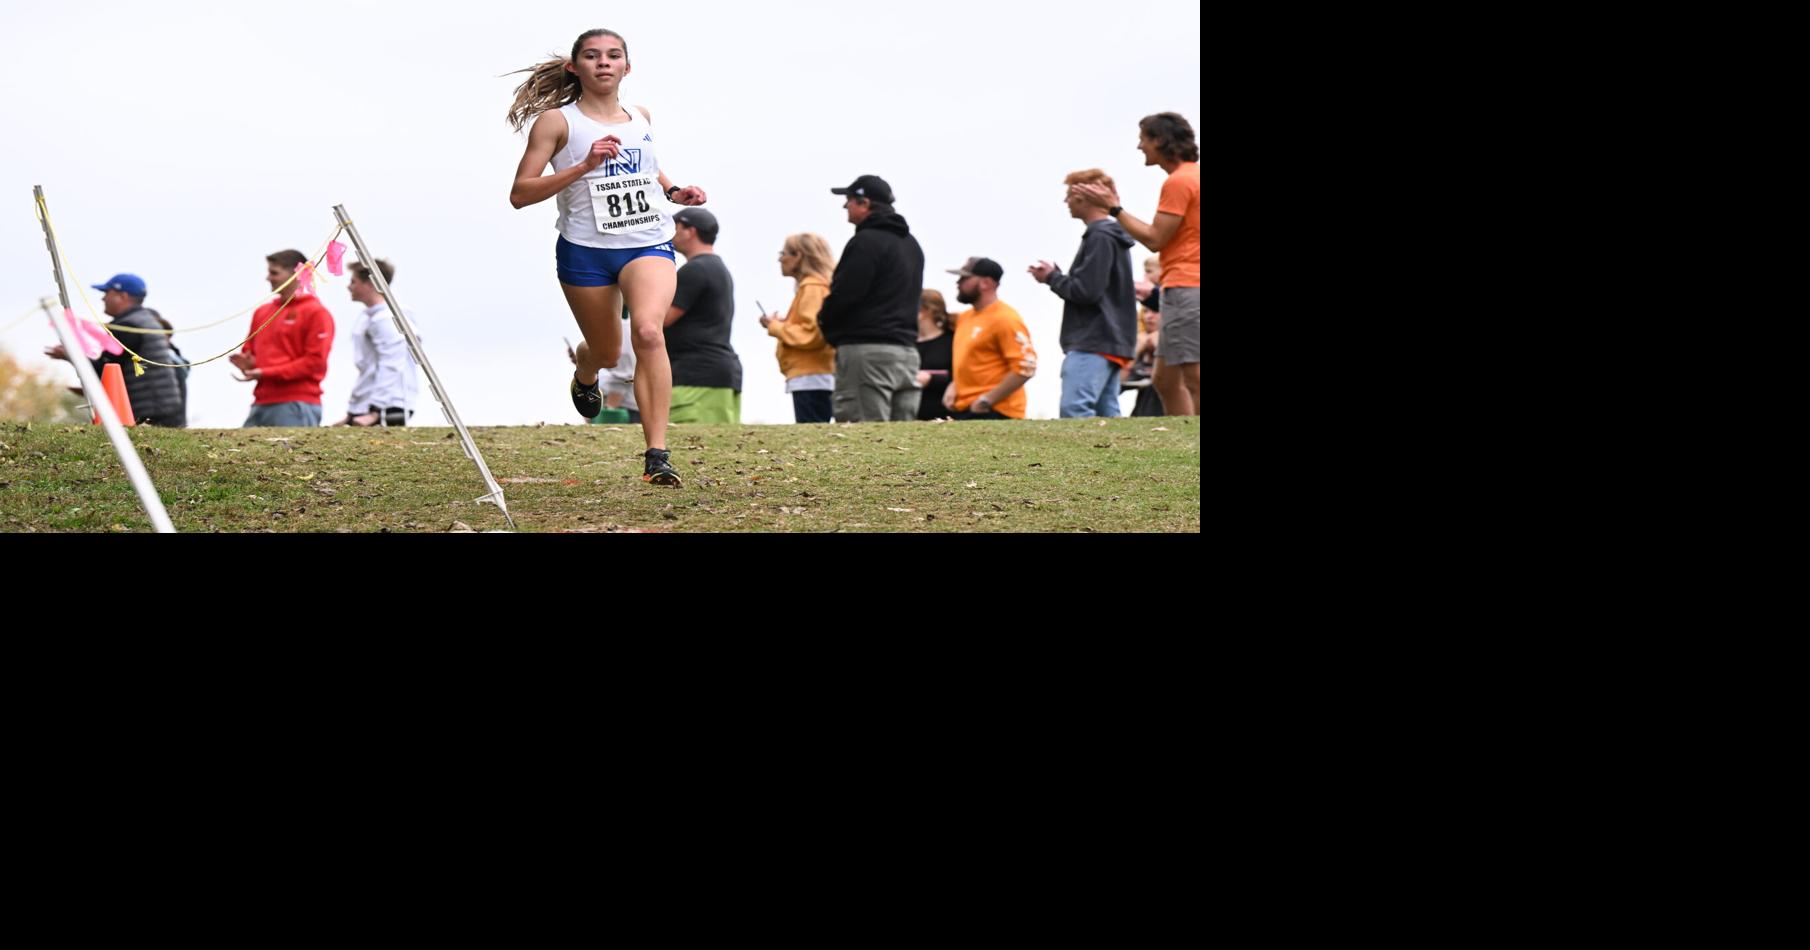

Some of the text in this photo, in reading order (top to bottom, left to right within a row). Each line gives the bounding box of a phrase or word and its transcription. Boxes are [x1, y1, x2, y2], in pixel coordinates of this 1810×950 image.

[605, 148, 641, 177] N
[595, 182, 621, 192] TSSAA
[622, 179, 643, 188] STATE
[602, 214, 660, 230] CHAMPIONSHIPS
